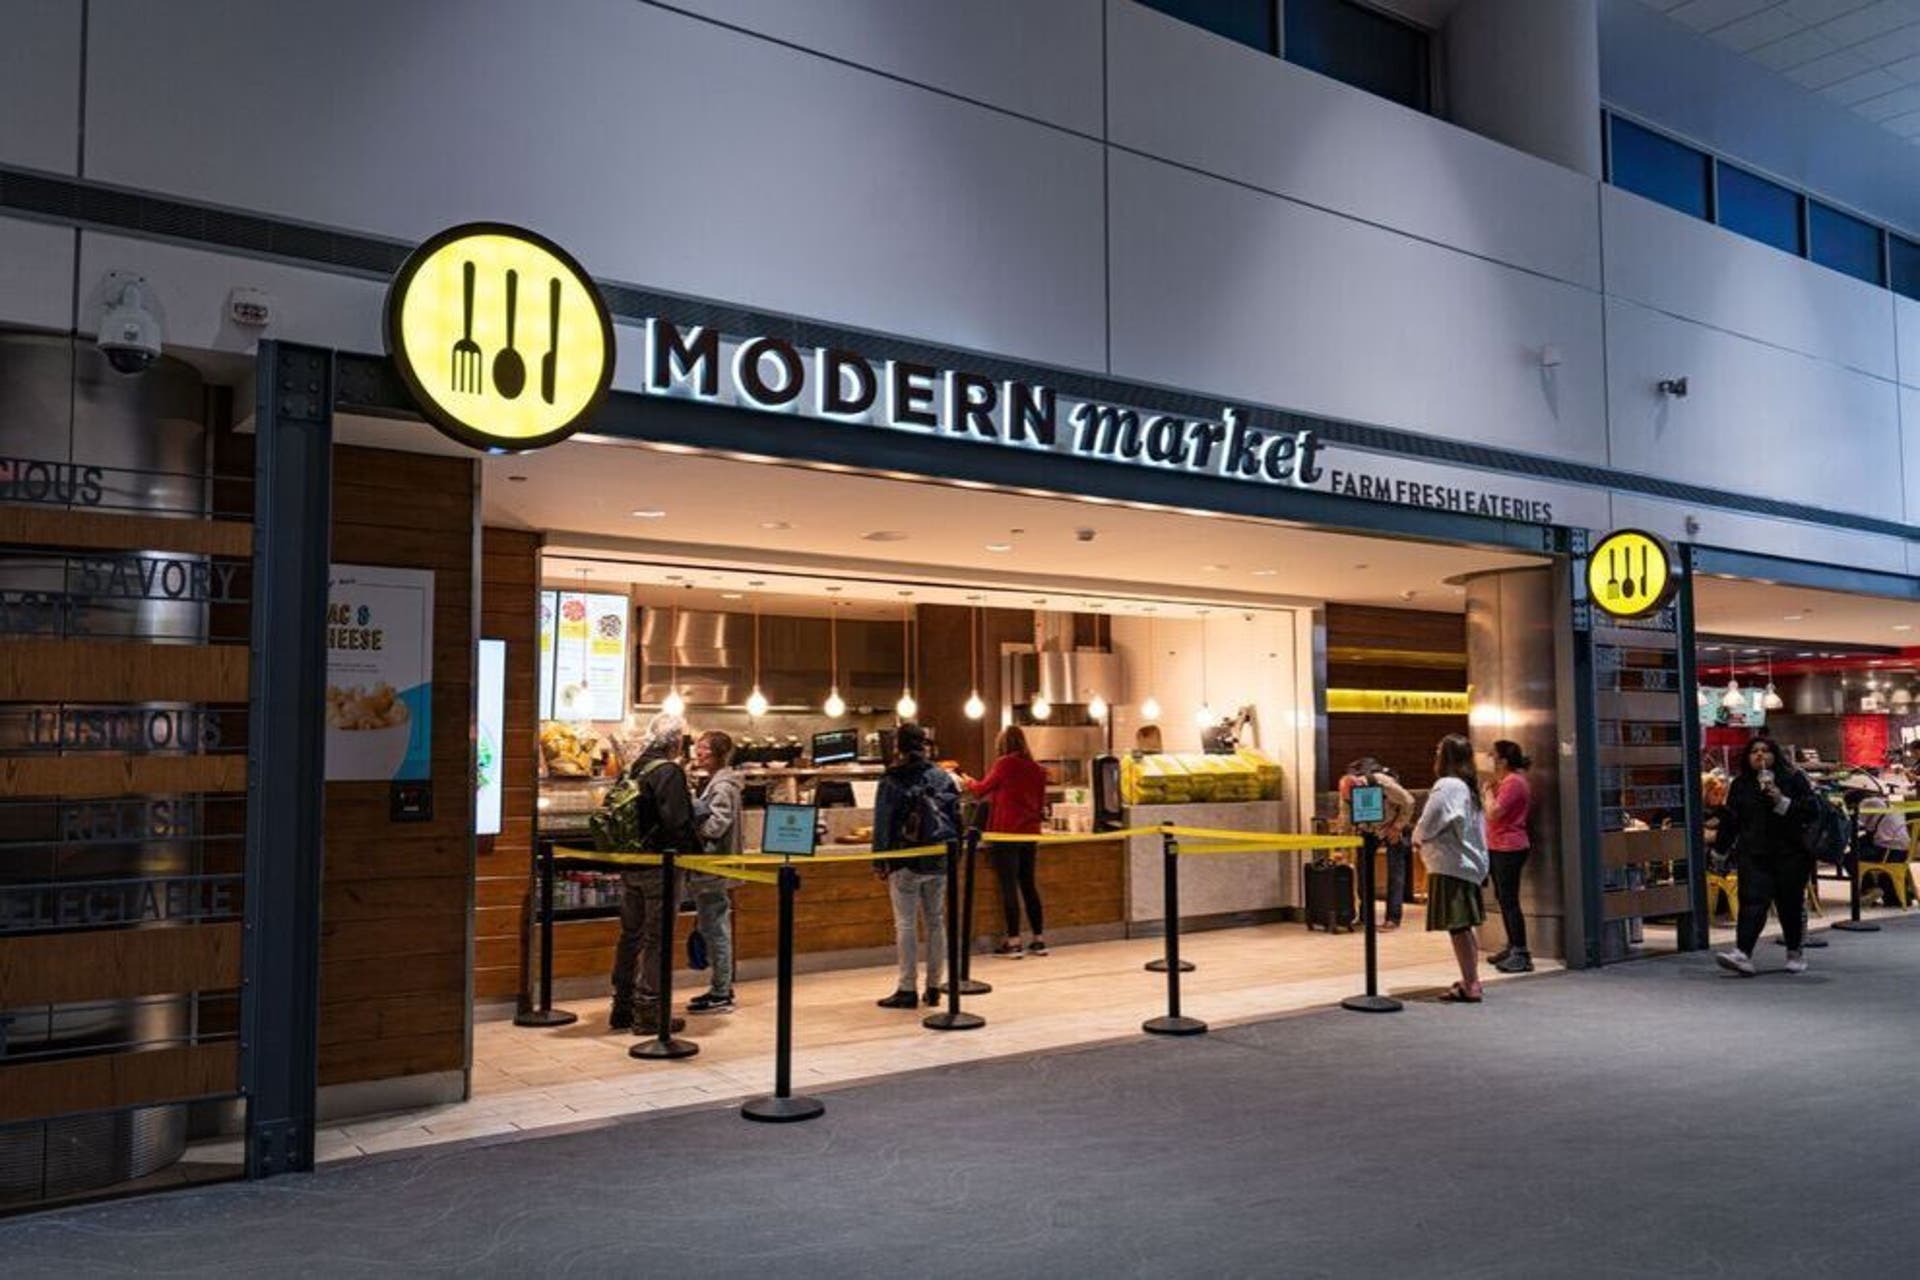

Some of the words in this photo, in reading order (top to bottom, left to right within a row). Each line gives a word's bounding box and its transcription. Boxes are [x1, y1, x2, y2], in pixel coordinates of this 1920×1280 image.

[646, 312, 1056, 448] MODERN
[1068, 402, 1325, 488] market
[1331, 470, 1391, 500] FARM
[1396, 480, 1460, 511] FRESH
[1466, 491, 1553, 522] EATERIES
[80, 558, 237, 600] SAVORY
